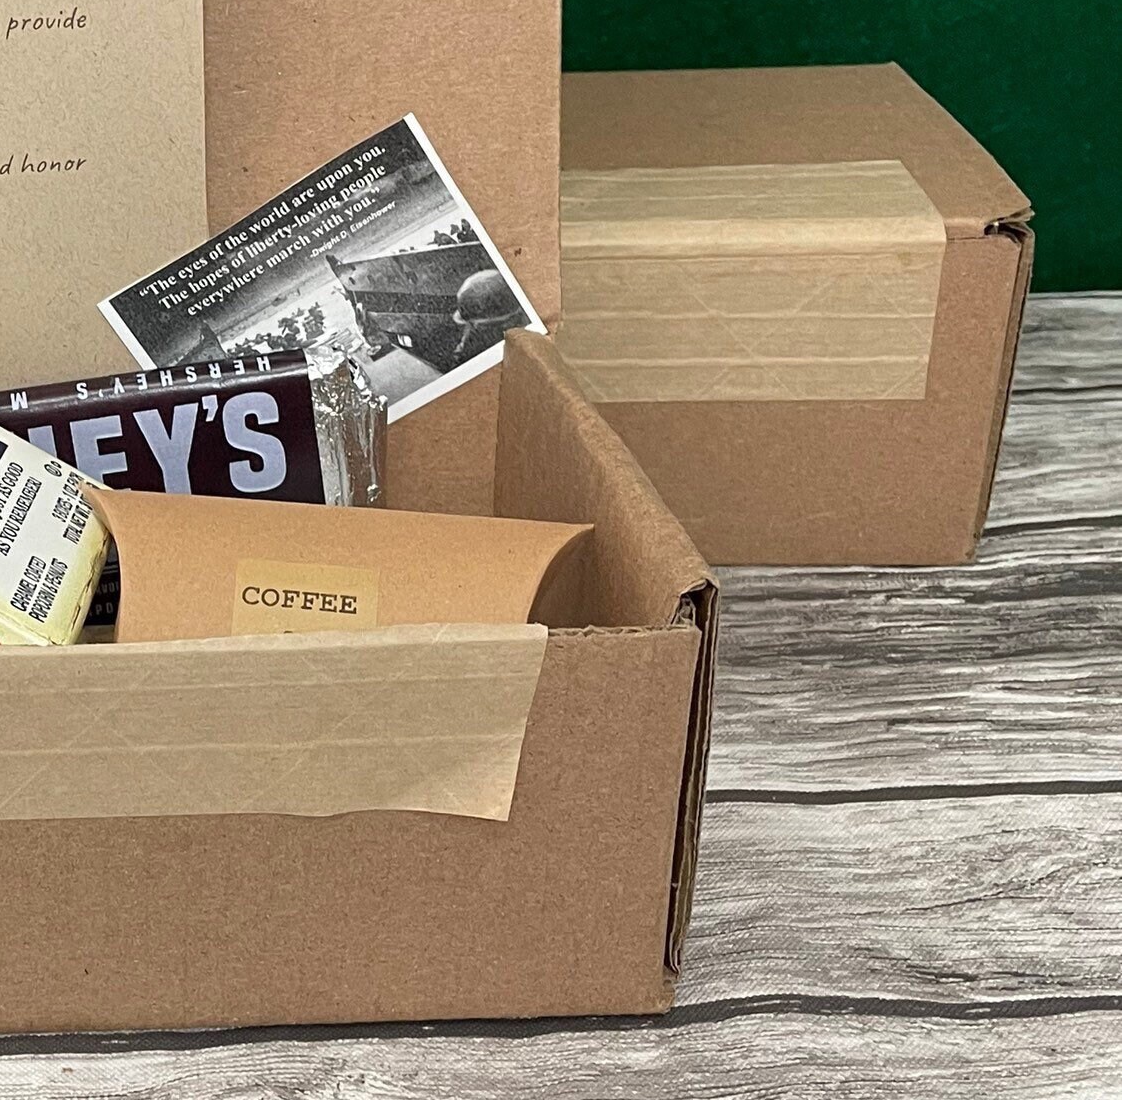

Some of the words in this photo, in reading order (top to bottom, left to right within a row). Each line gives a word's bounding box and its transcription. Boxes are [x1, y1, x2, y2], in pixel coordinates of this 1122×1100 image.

[6, 7, 87, 40] provide
[21, 153, 87, 174] honor
[177, 256, 208, 278] eyes
[209, 243, 224, 260] of
[225, 231, 249, 250] the
[249, 201, 291, 234] world
[291, 188, 315, 208] are
[316, 163, 354, 193] upon
[353, 145, 386, 171] you.
[350, 201, 396, 233] Eisenhower
[158, 289, 190, 309] The
[188, 265, 230, 294] hopes
[231, 250, 247, 268] of
[245, 195, 341, 258] liberty-loving
[339, 164, 387, 203] people
[187, 264, 265, 316] everywhere
[266, 234, 311, 268] march
[311, 212, 344, 238] with
[75, 355, 272, 400] HERSHEY'S
[2, 462, 24, 487] GOOD
[0, 520, 20, 543] YOU
[241, 586, 357, 615] COFFEE
